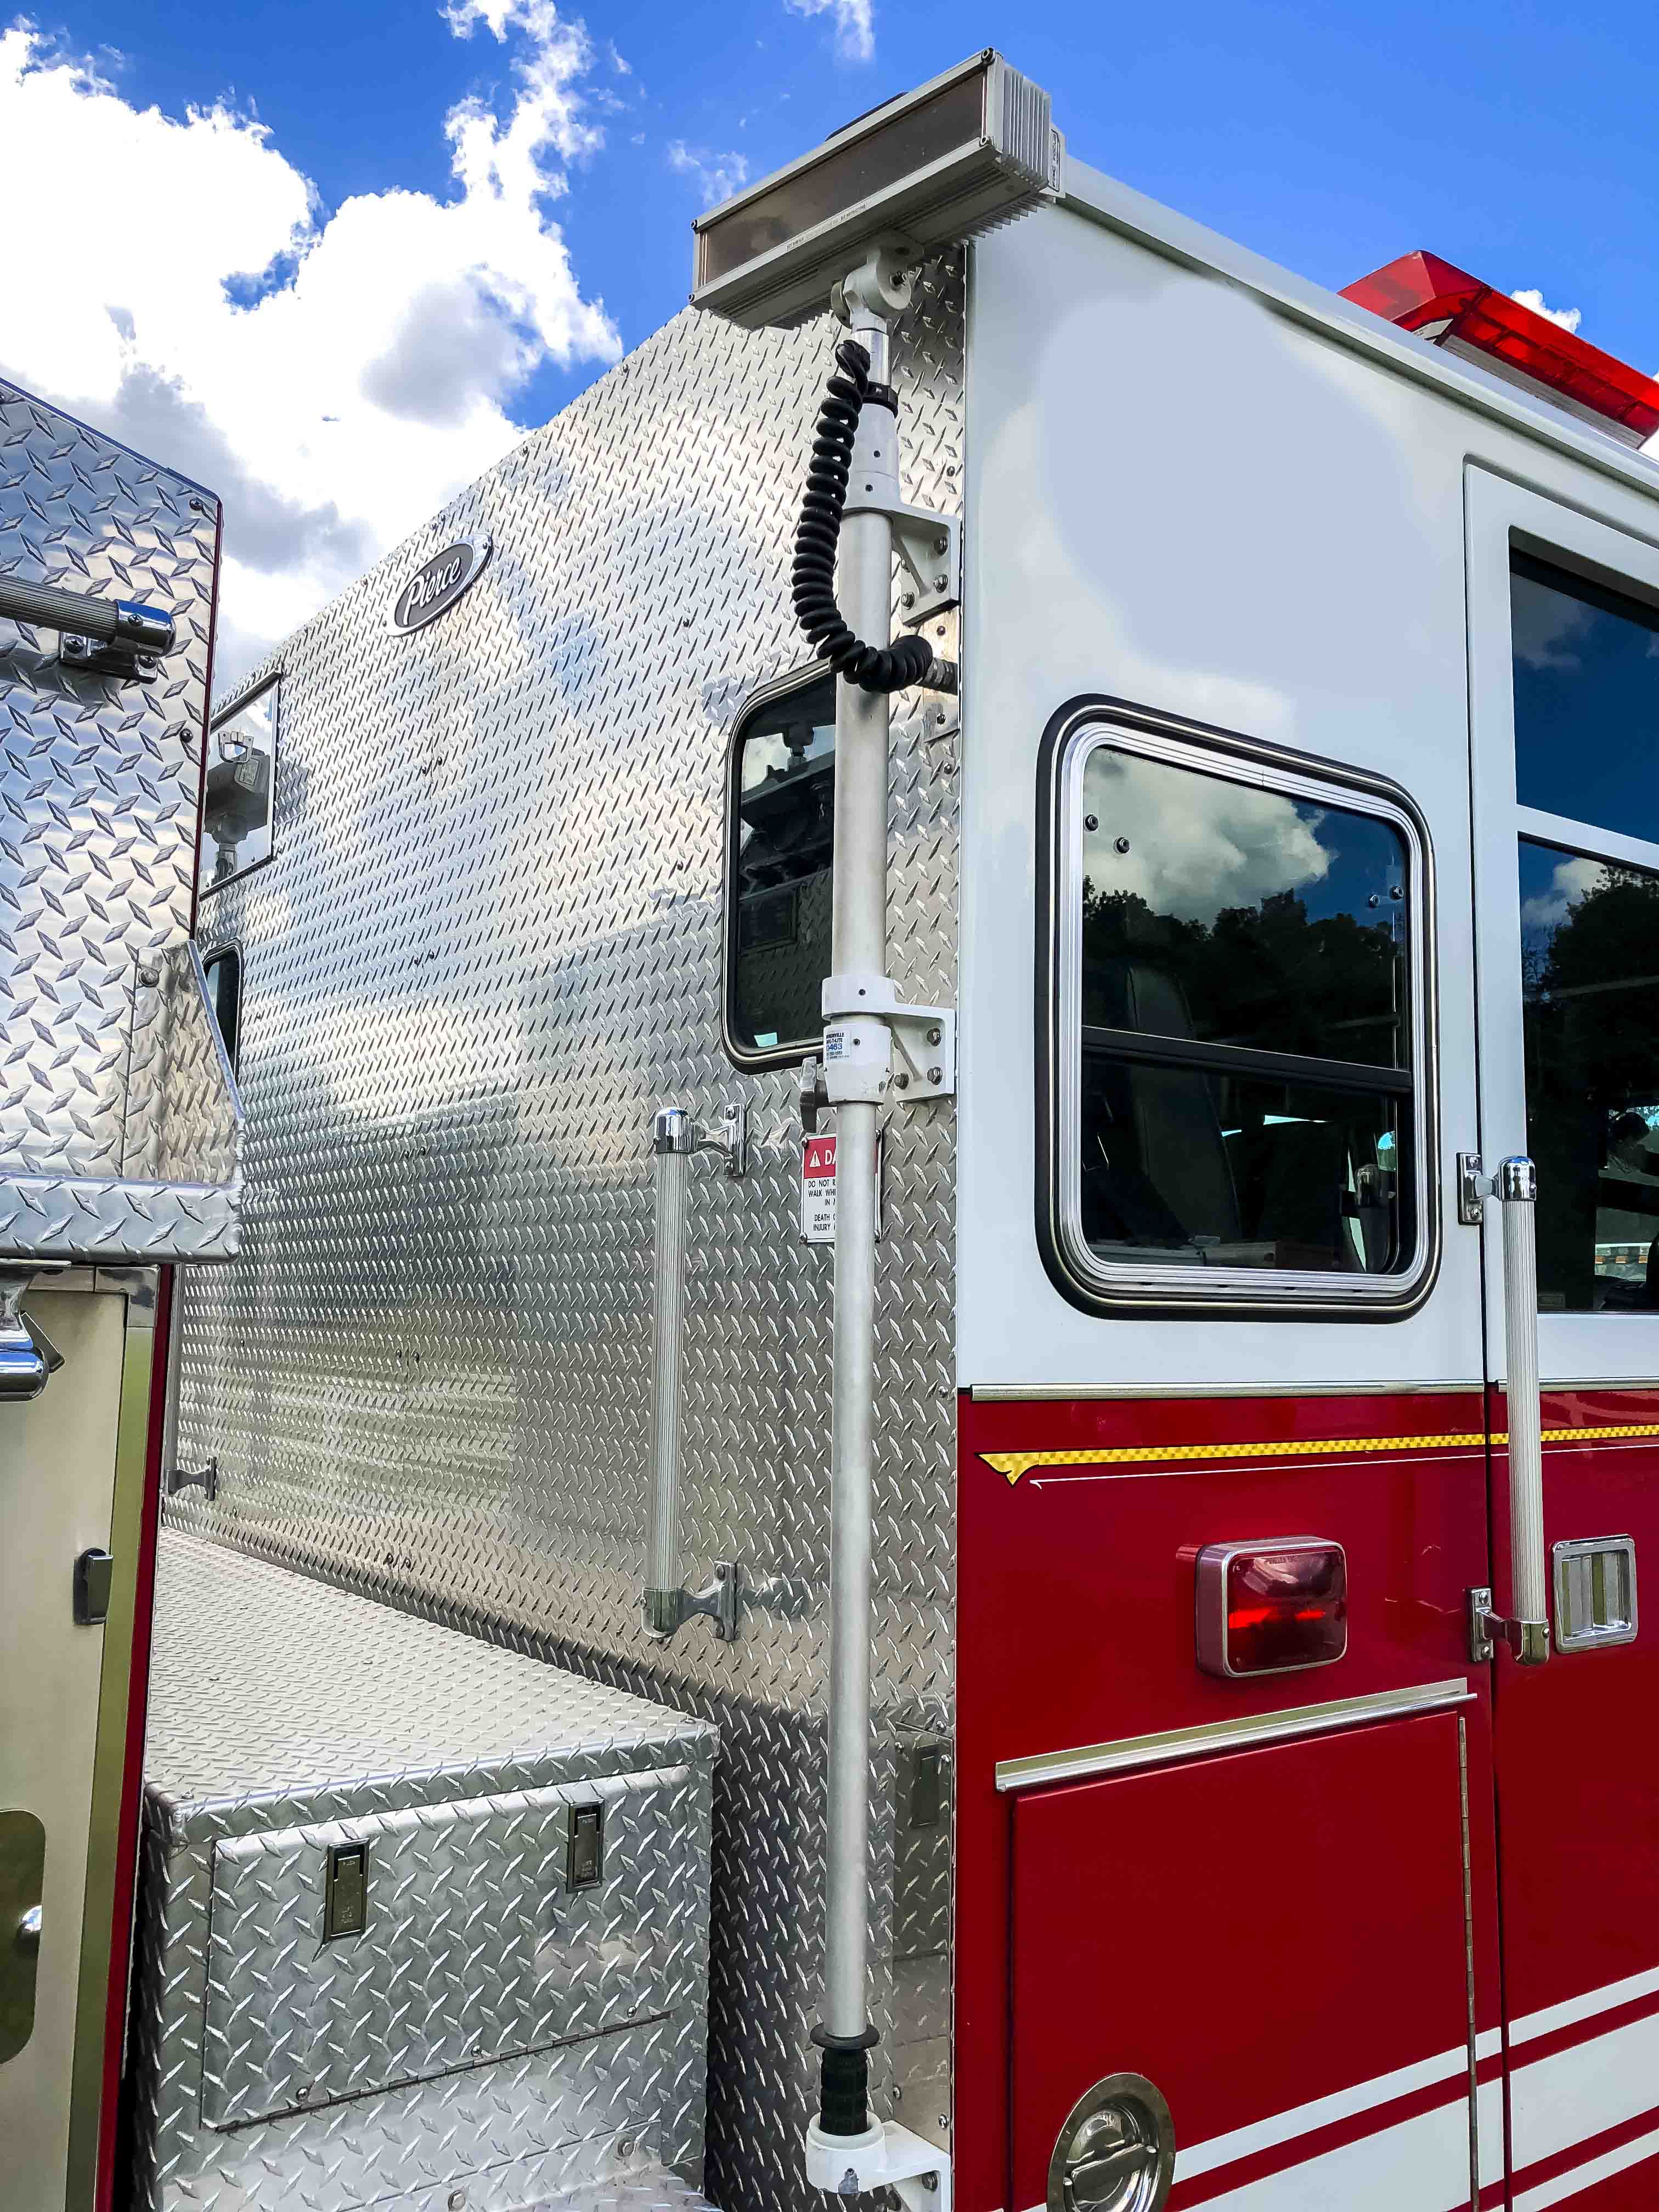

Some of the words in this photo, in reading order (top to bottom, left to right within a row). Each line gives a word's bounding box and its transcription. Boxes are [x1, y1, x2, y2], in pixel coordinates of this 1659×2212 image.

[403, 557, 462, 626] Pierce
[819, 1179, 830, 1187] NOT
[808, 1189, 822, 1197] WALK
